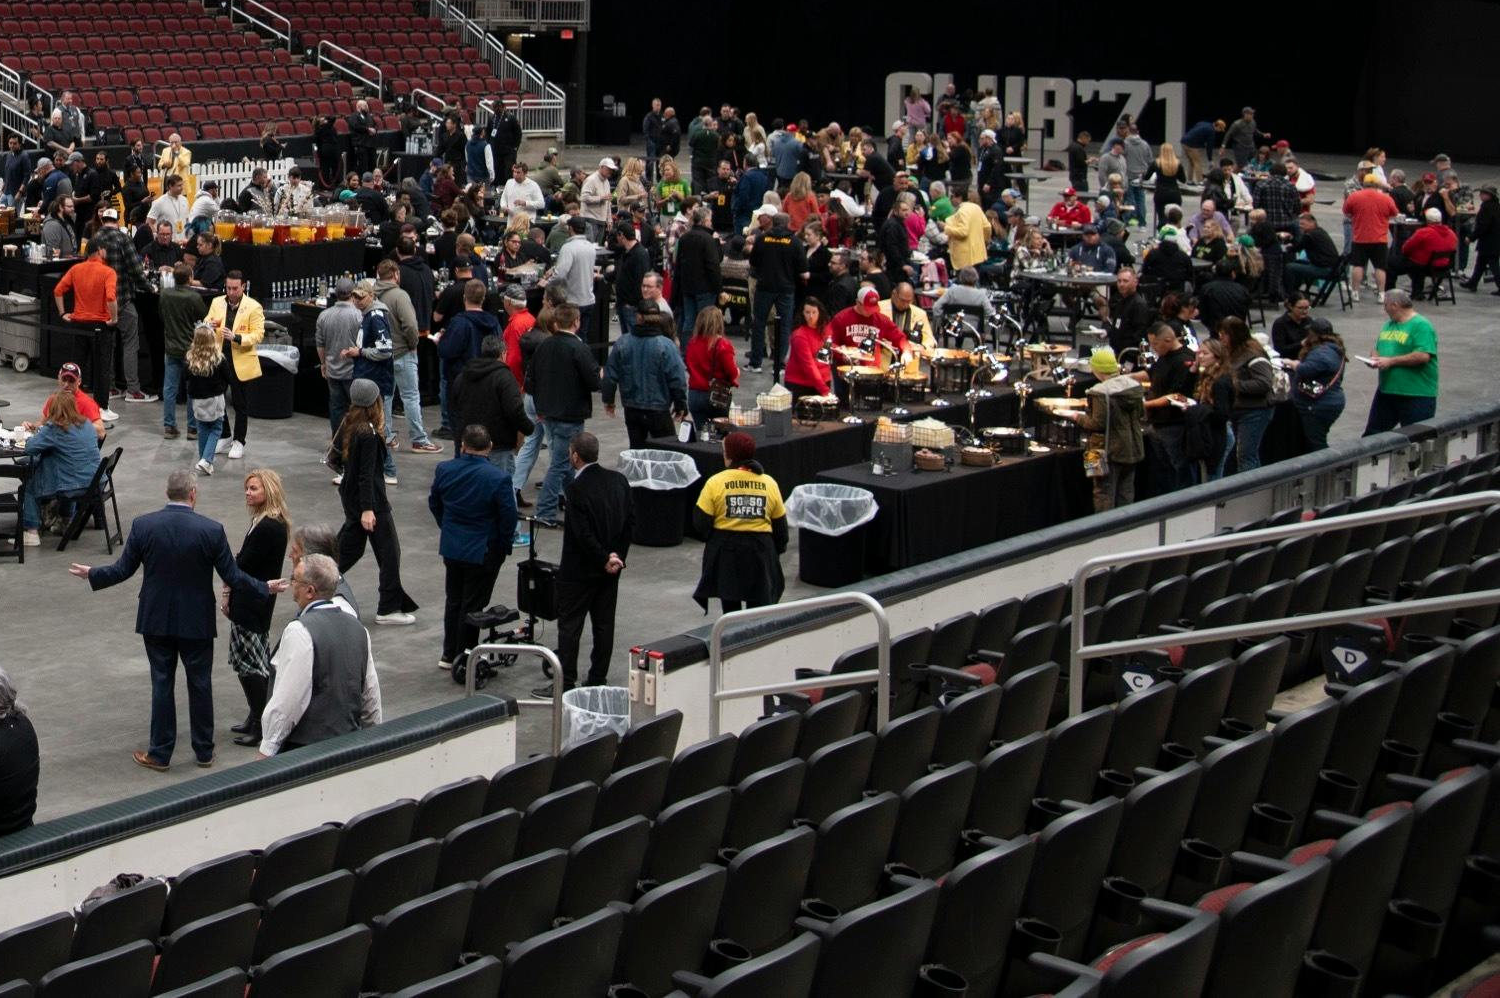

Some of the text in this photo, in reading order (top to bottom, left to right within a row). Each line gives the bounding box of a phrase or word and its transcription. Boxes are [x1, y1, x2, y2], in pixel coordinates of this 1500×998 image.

[884, 71, 1076, 151] CUB
[724, 480, 767, 491] VOLUNTEER
[730, 506, 763, 516] RAFFLE
[1344, 651, 1356, 664] D
[1132, 675, 1143, 688] C
